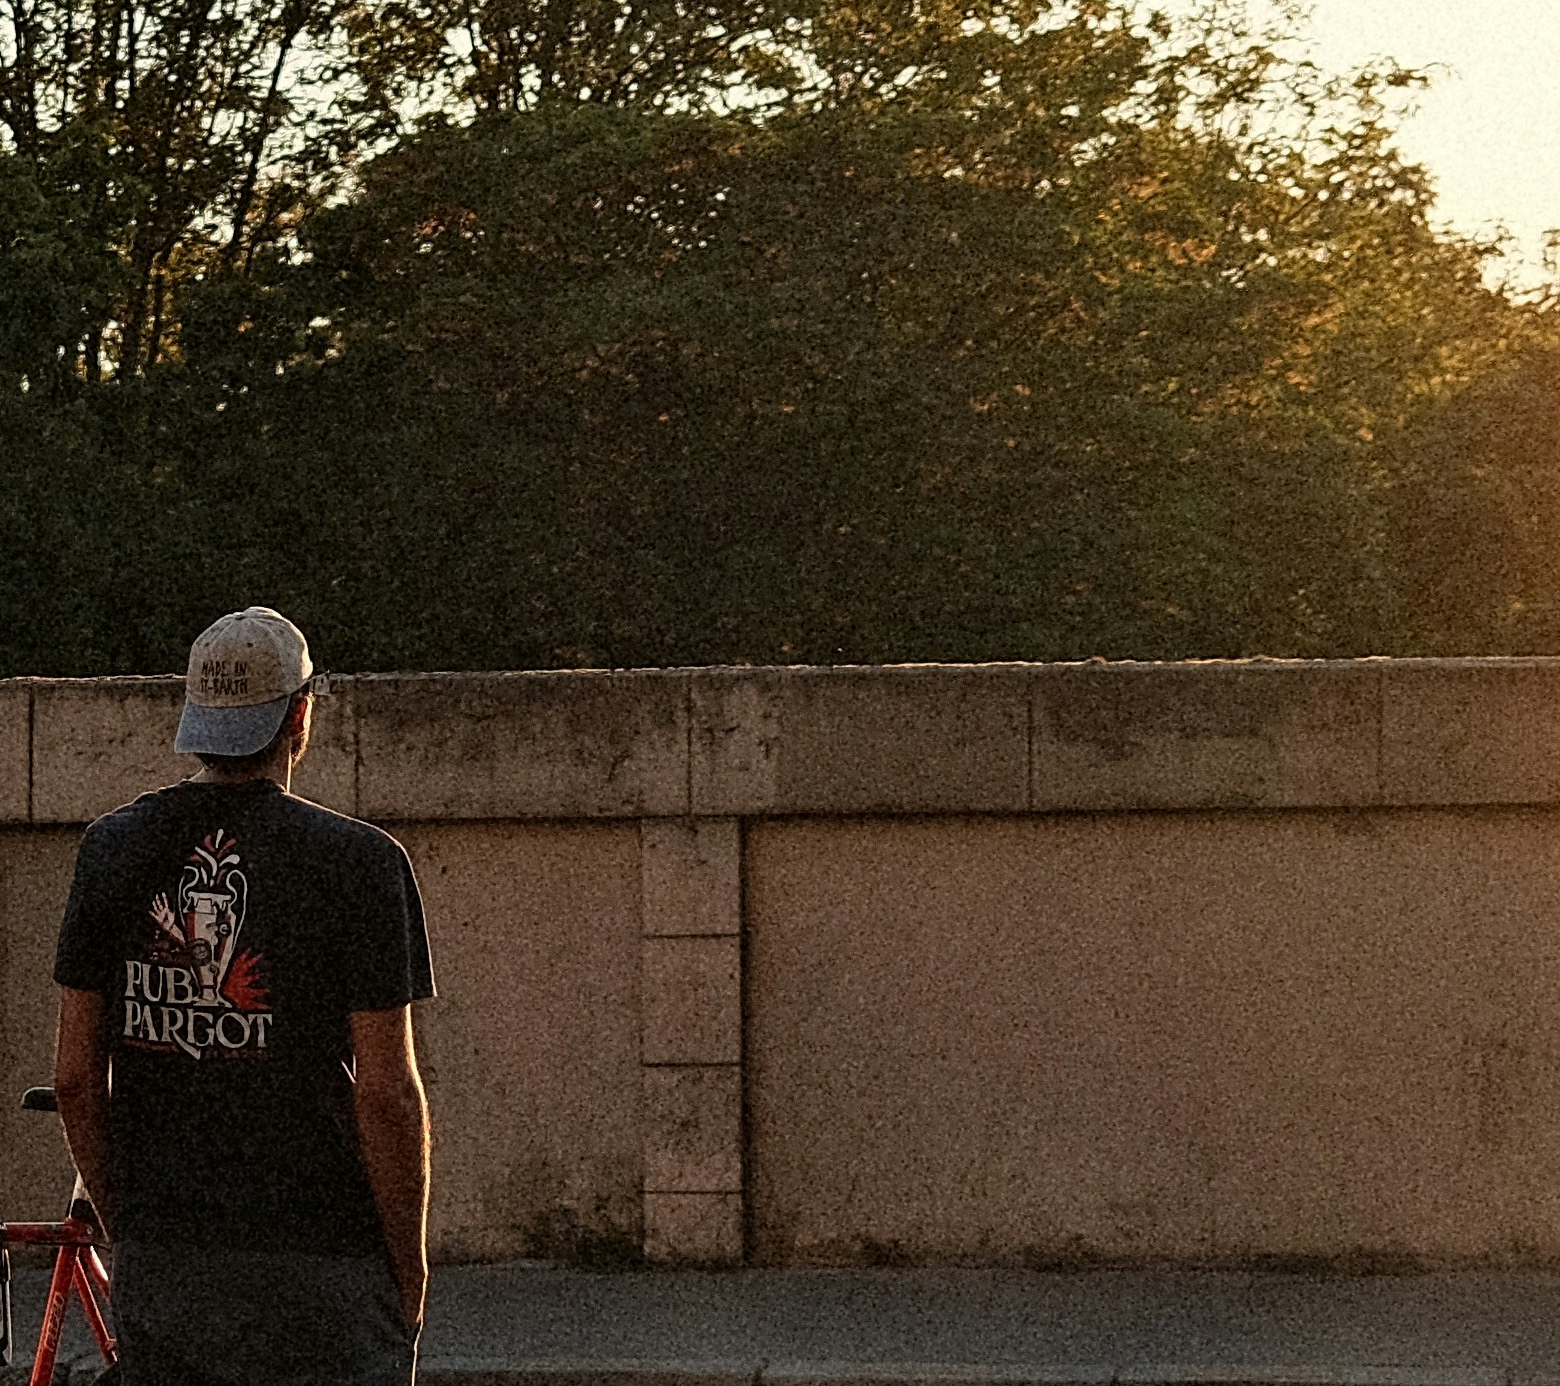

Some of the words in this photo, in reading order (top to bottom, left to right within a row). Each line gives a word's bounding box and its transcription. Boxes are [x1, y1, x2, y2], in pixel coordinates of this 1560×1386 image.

[201, 659, 229, 677] MADE
[235, 660, 248, 677] IN
[124, 959, 194, 1004] PUB
[123, 999, 273, 1060] PARGOT
